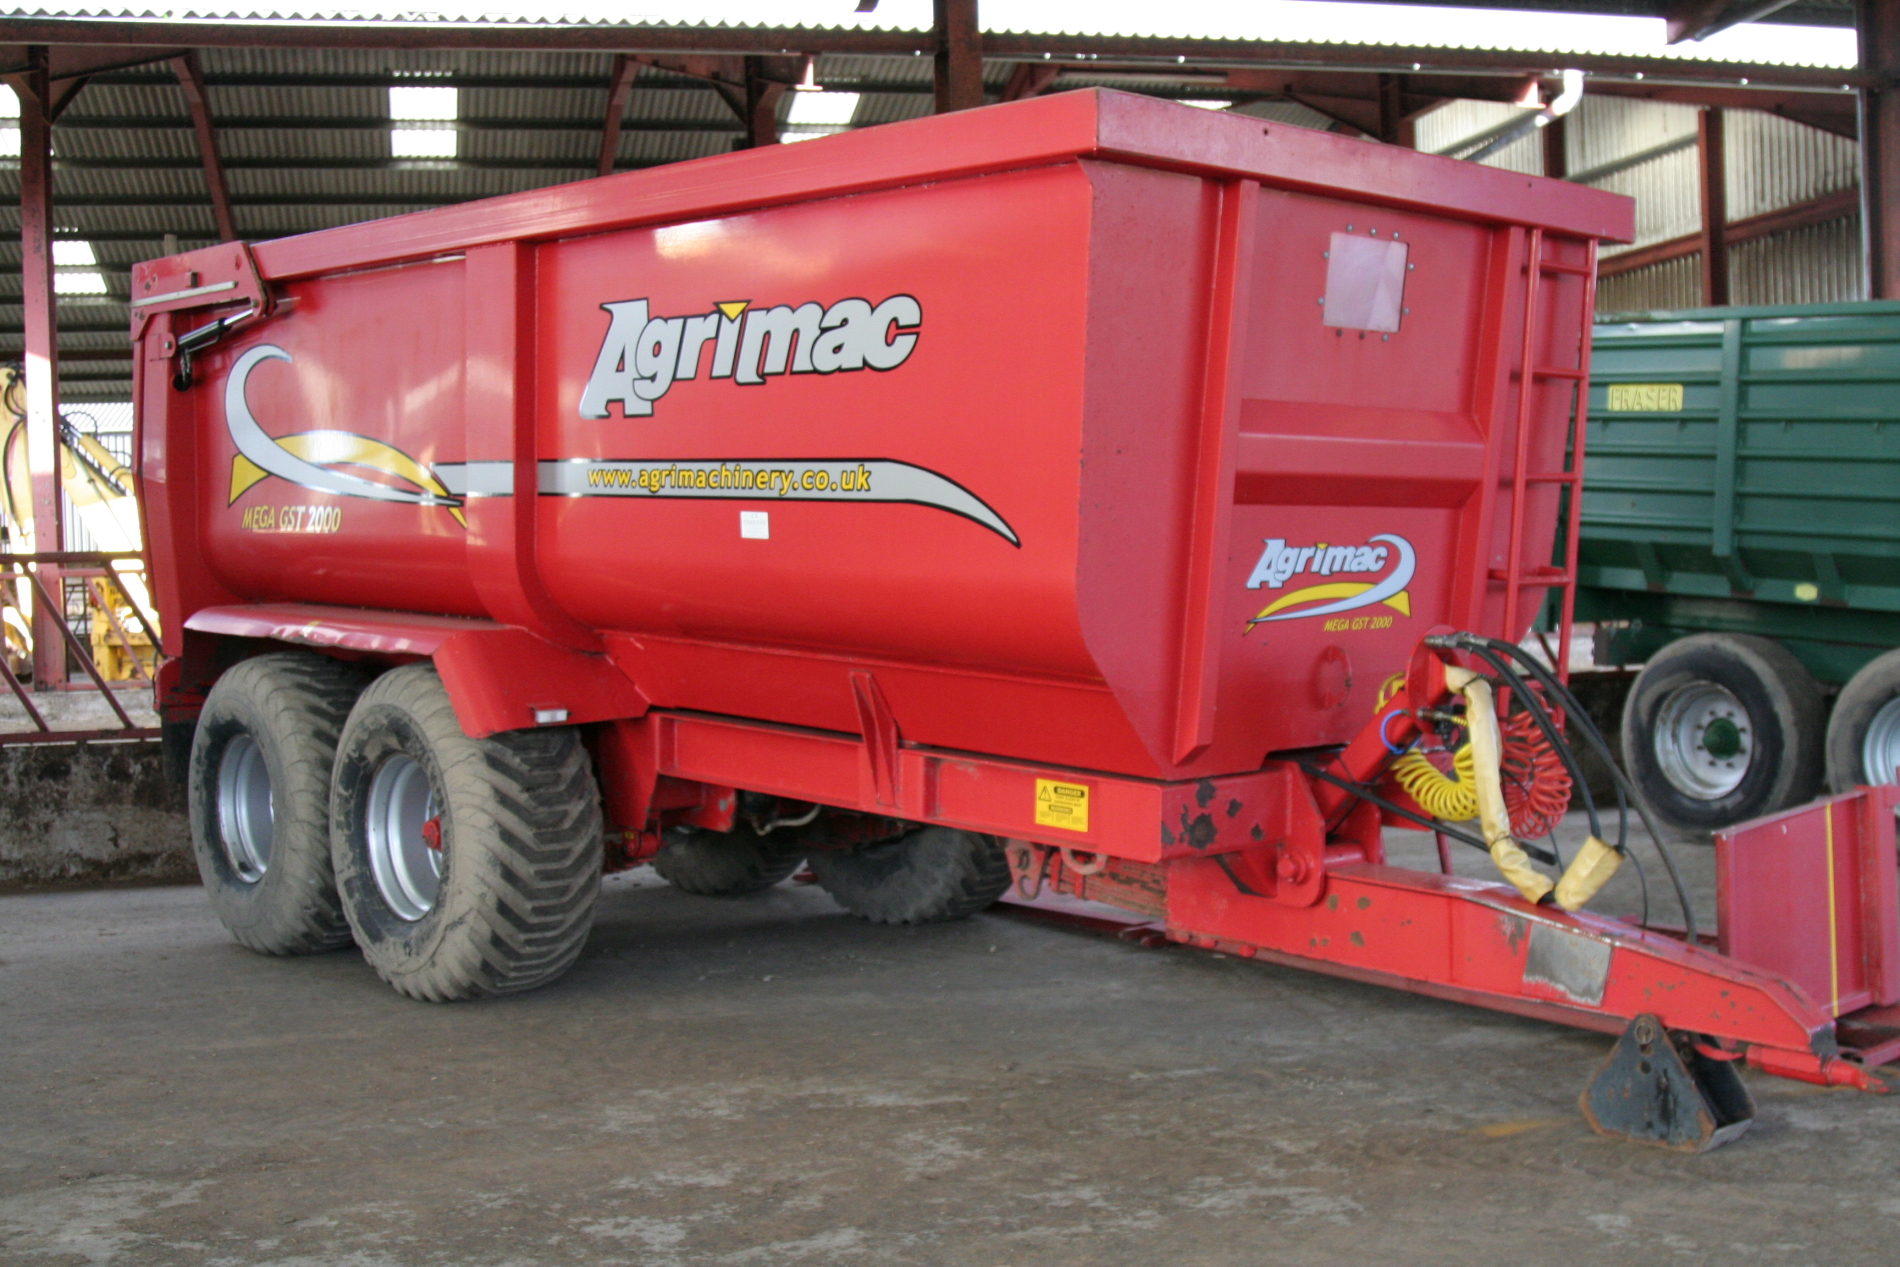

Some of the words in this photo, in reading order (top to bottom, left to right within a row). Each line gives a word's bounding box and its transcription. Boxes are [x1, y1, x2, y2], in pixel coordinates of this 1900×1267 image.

[579, 294, 922, 420] Agrimac
[1610, 386, 1679, 411] FRASER
[587, 463, 872, 496] www.agrimachinery.co.uk
[241, 505, 276, 530] MEGA
[278, 505, 306, 532] GST
[306, 505, 342, 533] 2000
[1246, 537, 1389, 590] Agrimac
[1324, 618, 1350, 632] MEGA
[1352, 617, 1370, 630] GST
[1370, 616, 1393, 629] 2000
